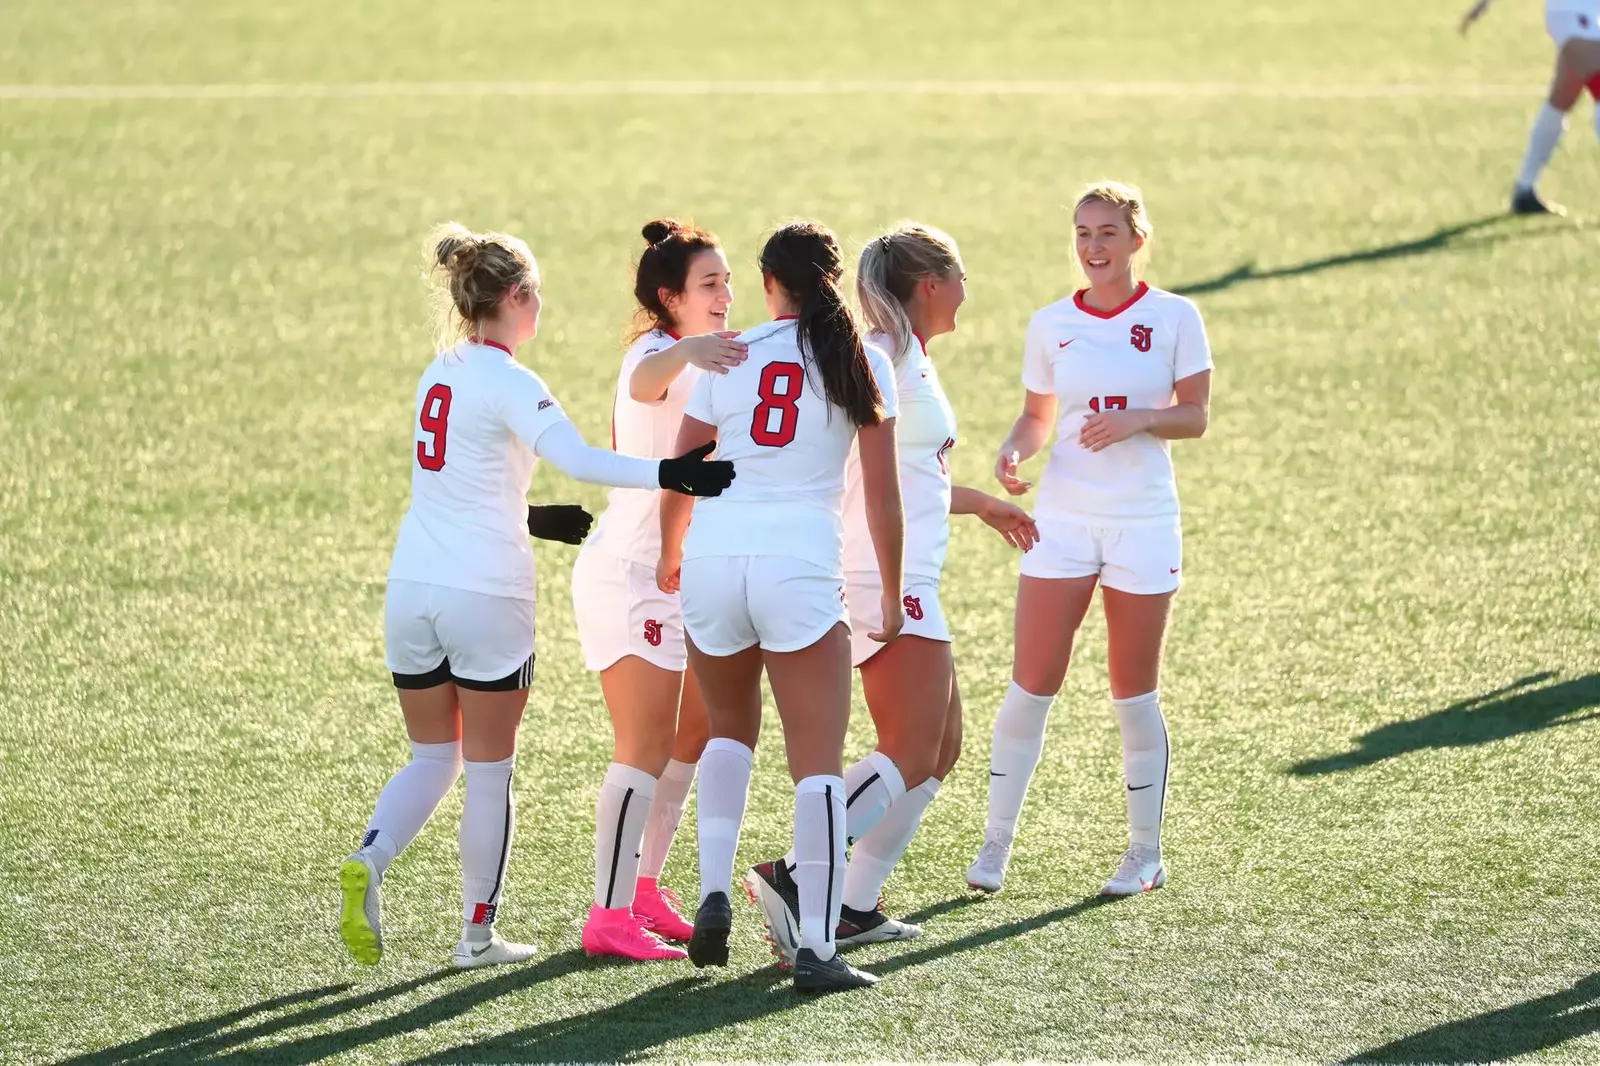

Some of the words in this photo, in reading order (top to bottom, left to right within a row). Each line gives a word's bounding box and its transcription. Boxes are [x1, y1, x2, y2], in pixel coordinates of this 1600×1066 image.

[1130, 324, 1153, 352] SJ
[750, 361, 805, 448] 8
[417, 383, 452, 472] 9
[903, 595, 923, 620] SJ
[644, 619, 663, 646] SJ
